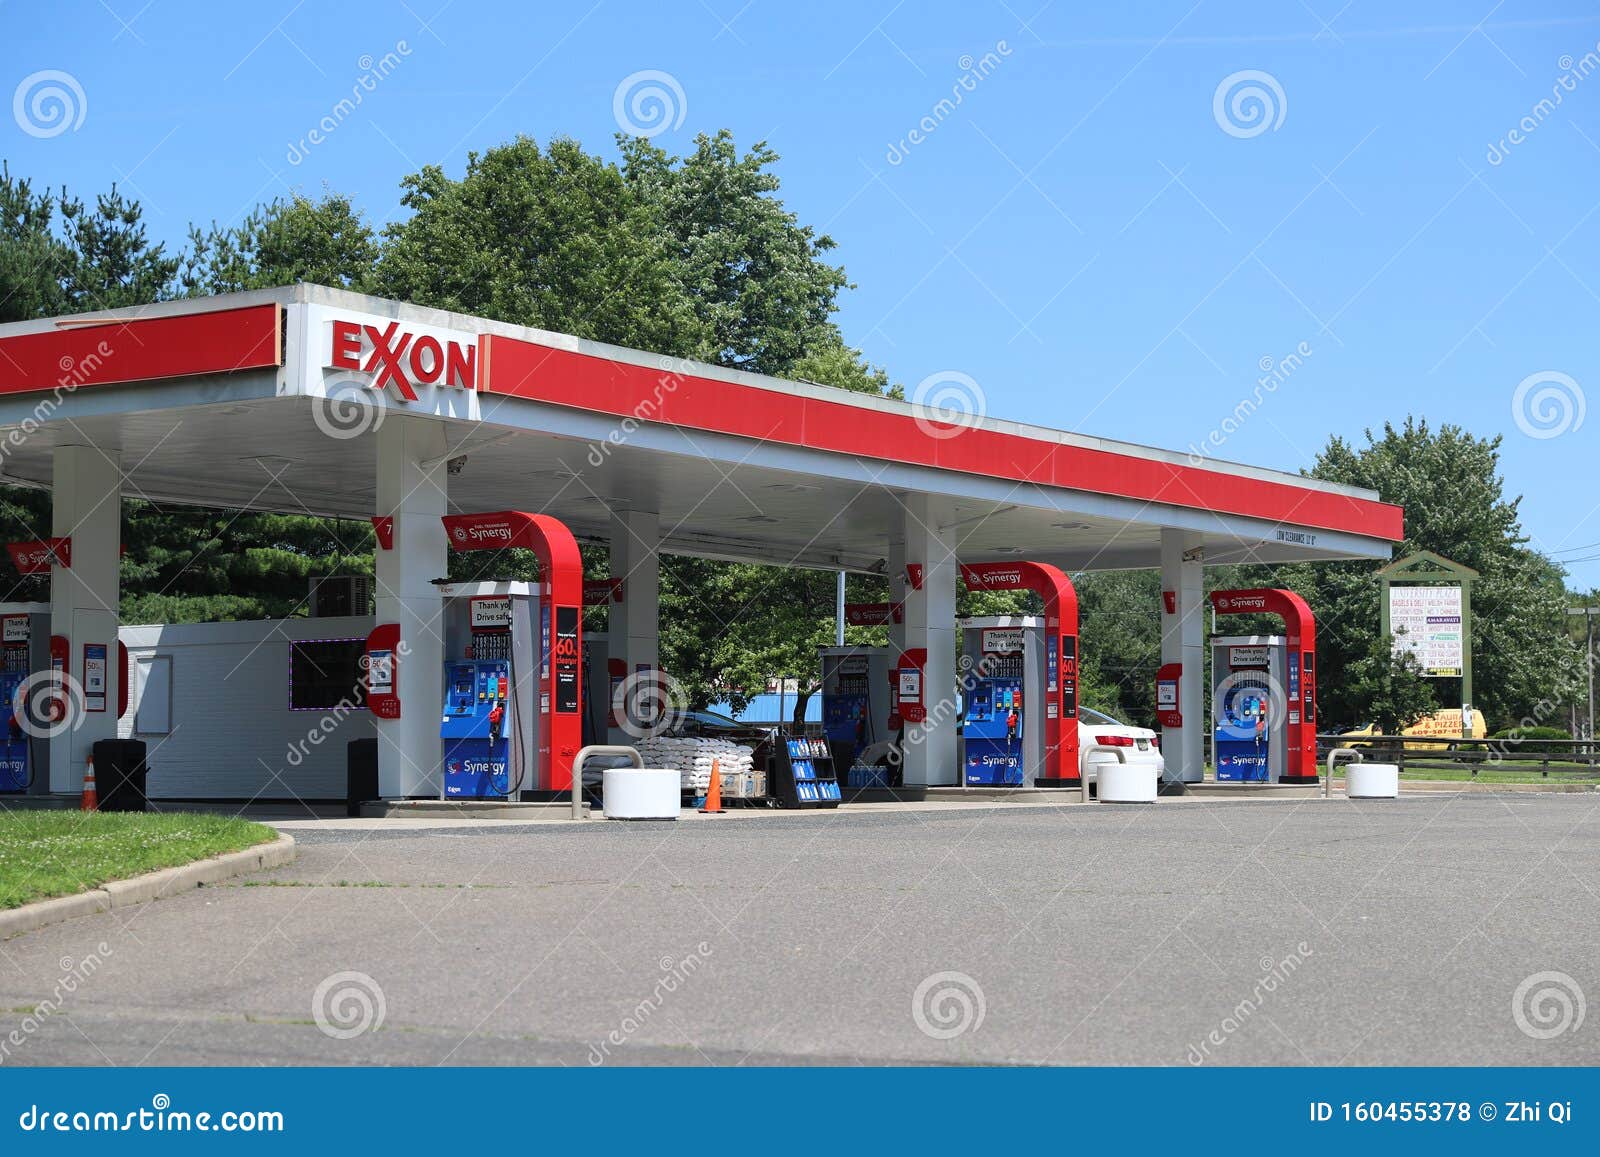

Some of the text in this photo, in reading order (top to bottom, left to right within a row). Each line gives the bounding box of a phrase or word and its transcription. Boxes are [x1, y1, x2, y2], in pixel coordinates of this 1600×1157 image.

[332, 319, 476, 401] EXXON
[469, 527, 512, 541] Synergy
[982, 573, 1021, 585] Synergy
[1230, 599, 1265, 608] Synergy
